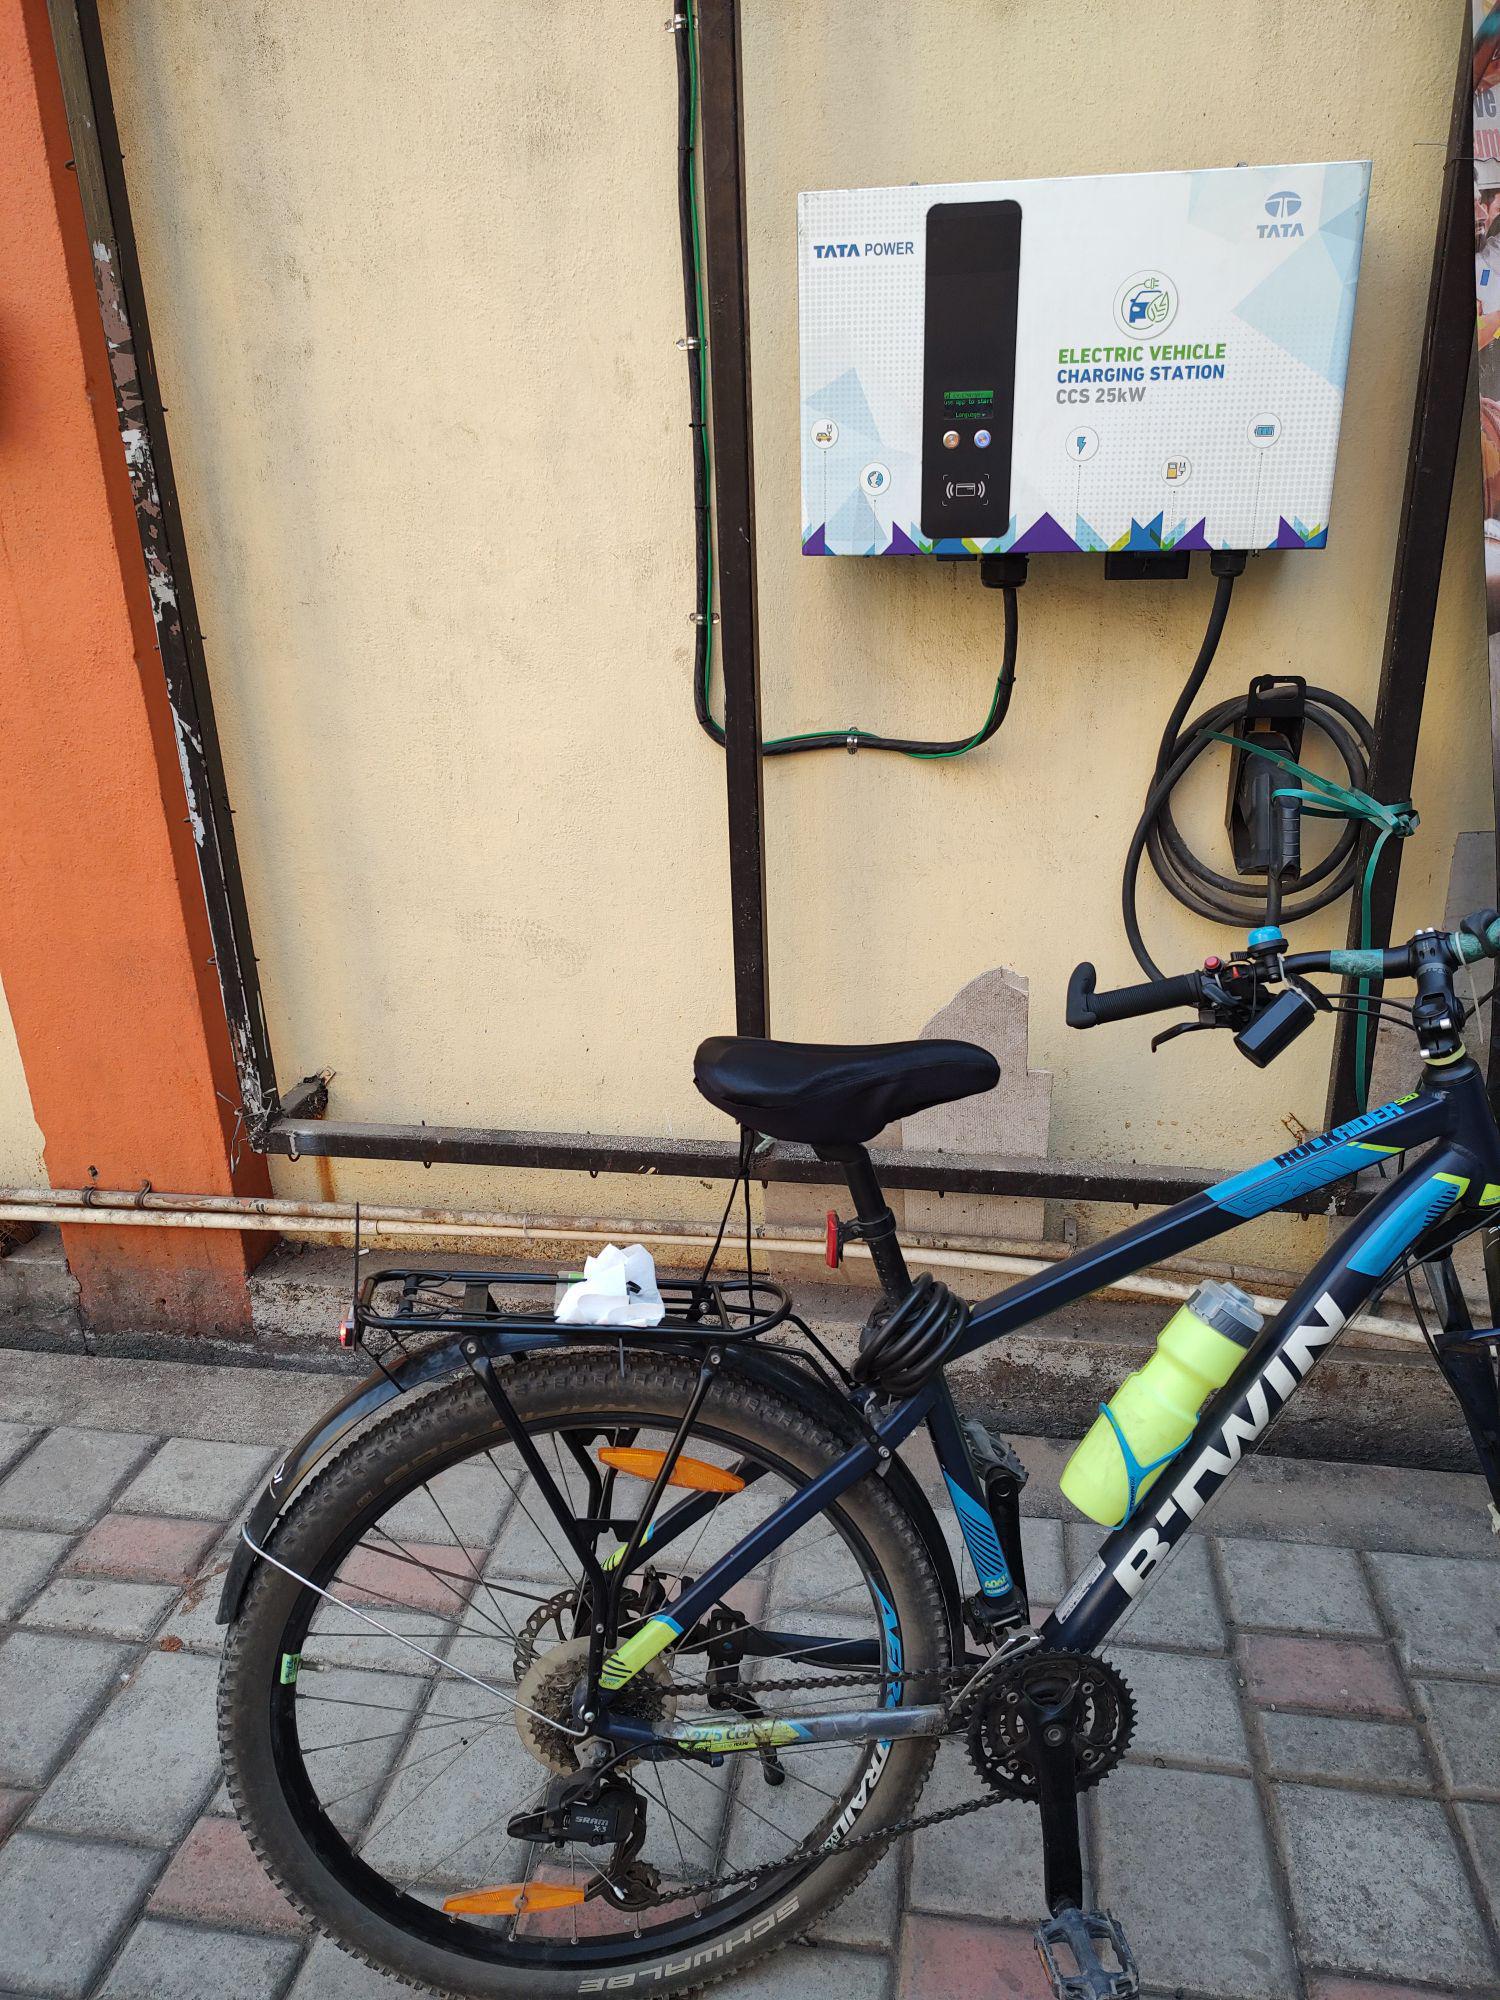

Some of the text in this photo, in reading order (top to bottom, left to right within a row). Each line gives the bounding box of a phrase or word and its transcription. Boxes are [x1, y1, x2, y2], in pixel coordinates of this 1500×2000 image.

[1256, 223, 1304, 239] TATA
[813, 242, 914, 258] TATA POWER
[1058, 343, 1227, 364] ELECTRIC VEHICLE
[1057, 364, 1225, 384] CHARGING STATION
[1056, 387, 1147, 405] CCS 25kW
[1273, 1102, 1405, 1169] ROCKRIDER
[575, 1816, 609, 1826] SRAM
[578, 1895, 800, 1993] SCHWALBE
